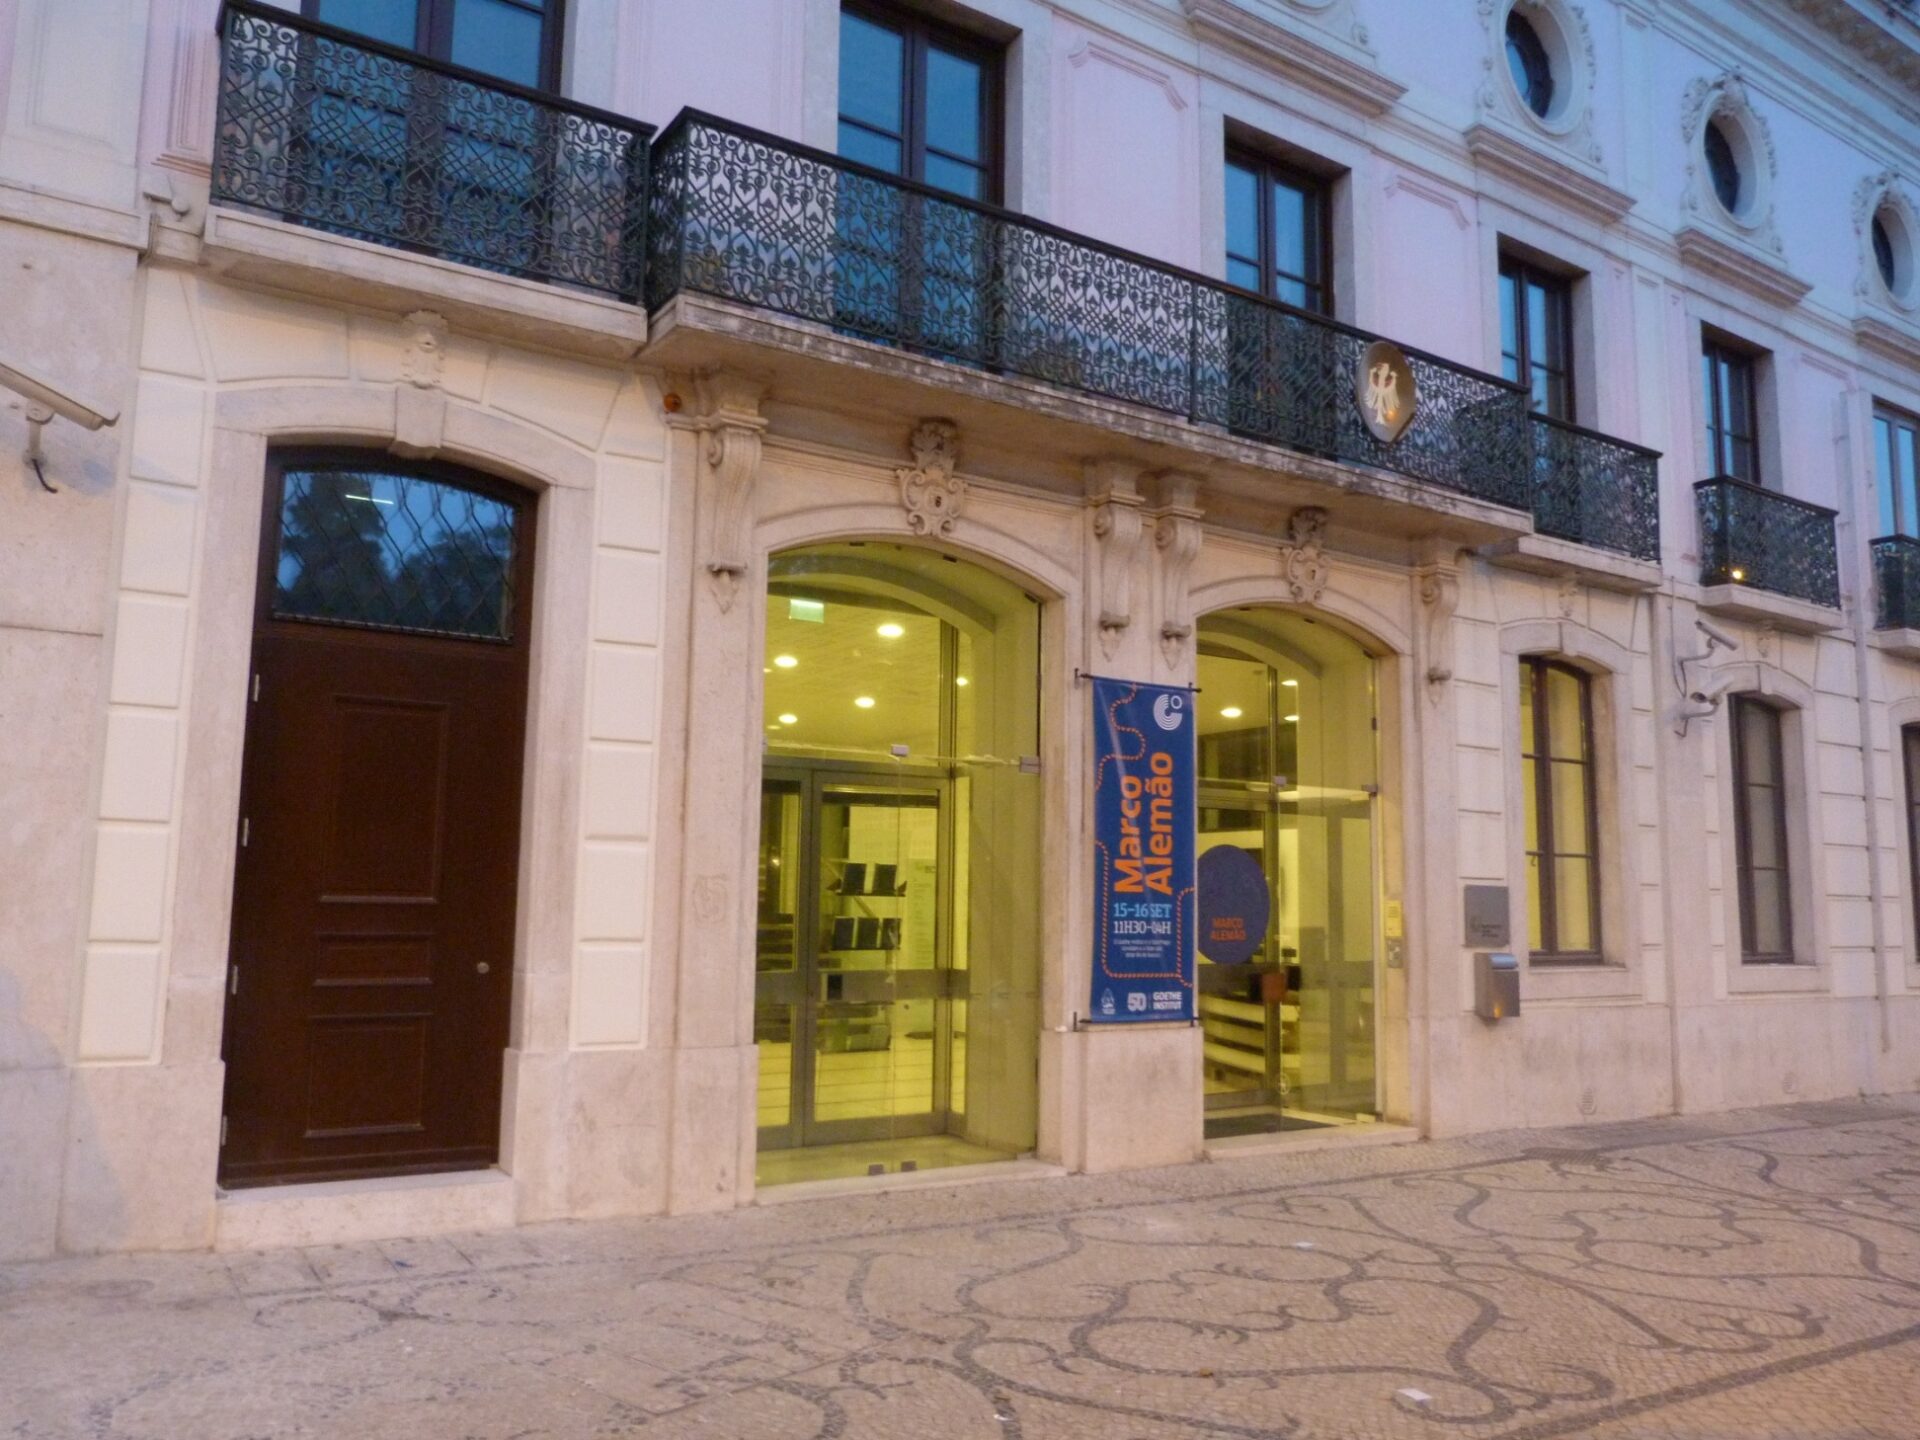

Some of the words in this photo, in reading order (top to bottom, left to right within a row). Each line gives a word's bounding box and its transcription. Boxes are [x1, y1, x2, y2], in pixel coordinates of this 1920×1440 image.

[1144, 752, 1173, 895] Alemão
[1114, 775, 1144, 892] Marco
[1113, 902, 1149, 918] 15-16
[1150, 903, 1172, 918] SET
[1212, 917, 1243, 929] MARCO
[1153, 991, 1182, 1000] GOETHE
